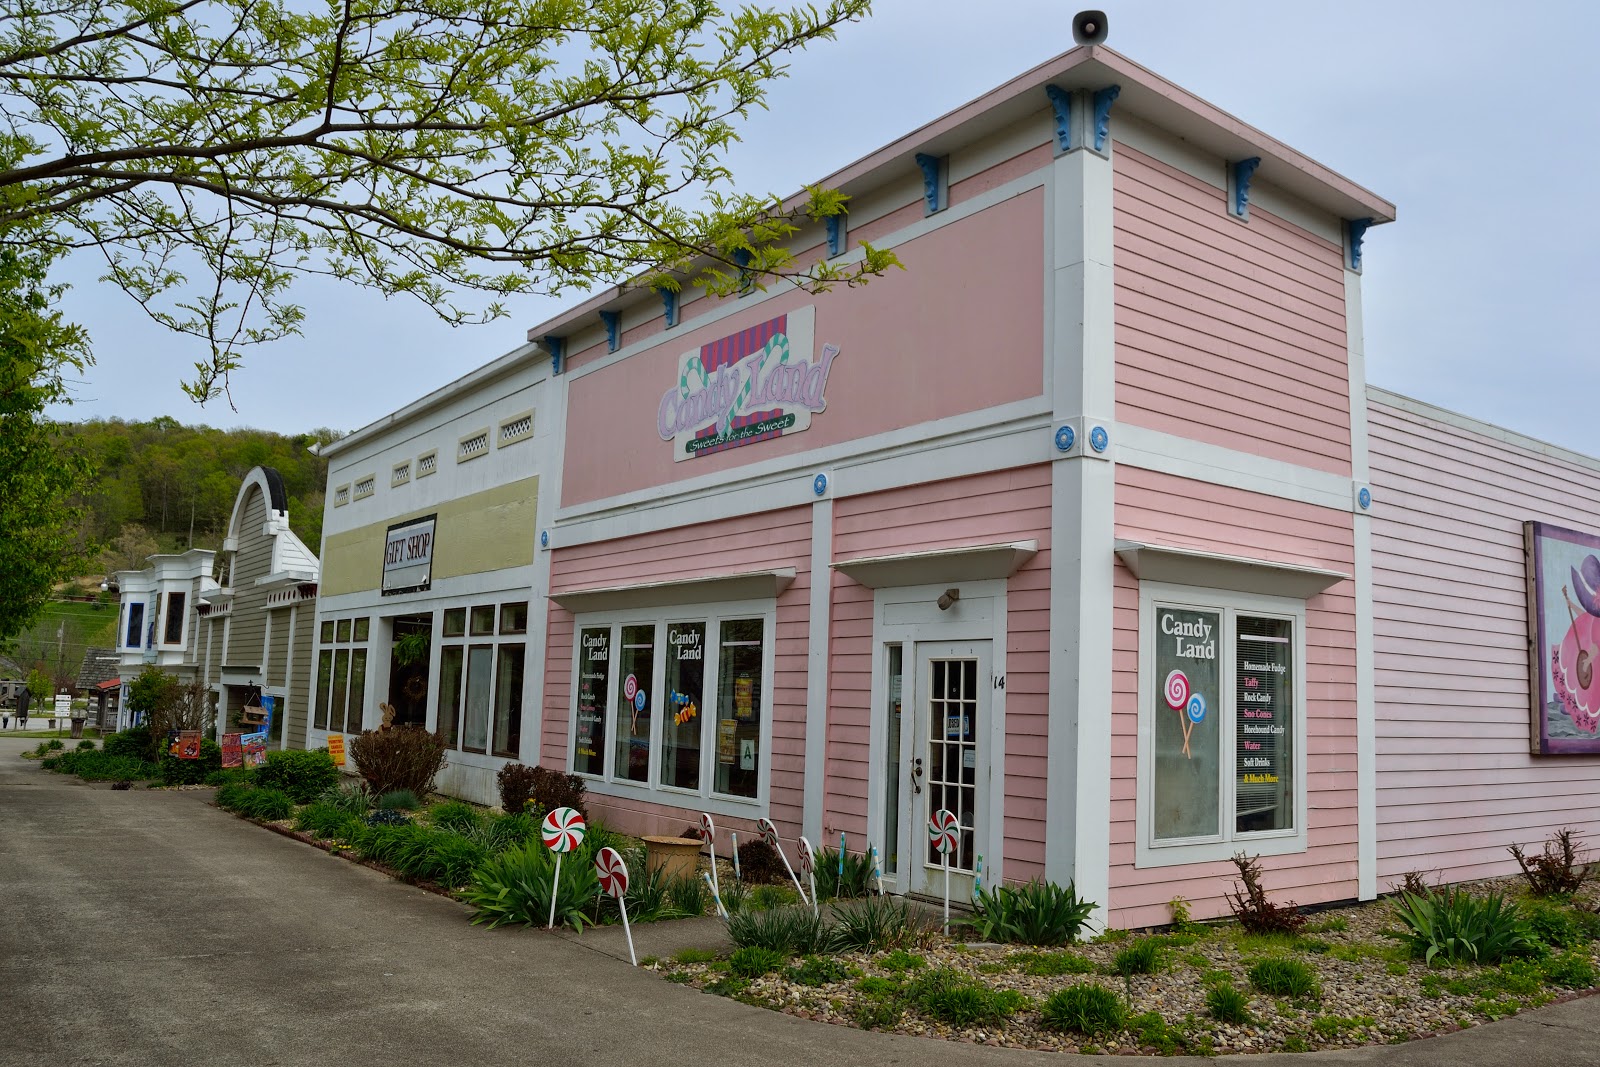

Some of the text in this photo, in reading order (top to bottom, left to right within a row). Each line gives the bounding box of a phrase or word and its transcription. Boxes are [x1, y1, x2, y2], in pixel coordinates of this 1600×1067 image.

[658, 346, 838, 433] Candy Land
[690, 417, 790, 452] Sweets for the Sweet
[386, 532, 431, 565] GIFT SHOP
[1161, 613, 1213, 644] Candy
[582, 633, 607, 651] Candy
[669, 629, 700, 649] Candy
[588, 646, 608, 661] Land
[677, 644, 702, 660] Land
[1175, 636, 1216, 660] Land
[1244, 661, 1286, 675] Homemade Fudge
[993, 675, 1005, 690] 14
[1244, 677, 1259, 690] Taffy
[1244, 692, 1271, 705] Rock Candy
[1244, 708, 1273, 719] Sno Cones
[1244, 724, 1285, 737] Horehound Candy
[743, 744, 752, 760] A
[1244, 741, 1261, 751] Water
[1243, 757, 1270, 767] Soft Drinks
[1243, 773, 1279, 783] & Much More
